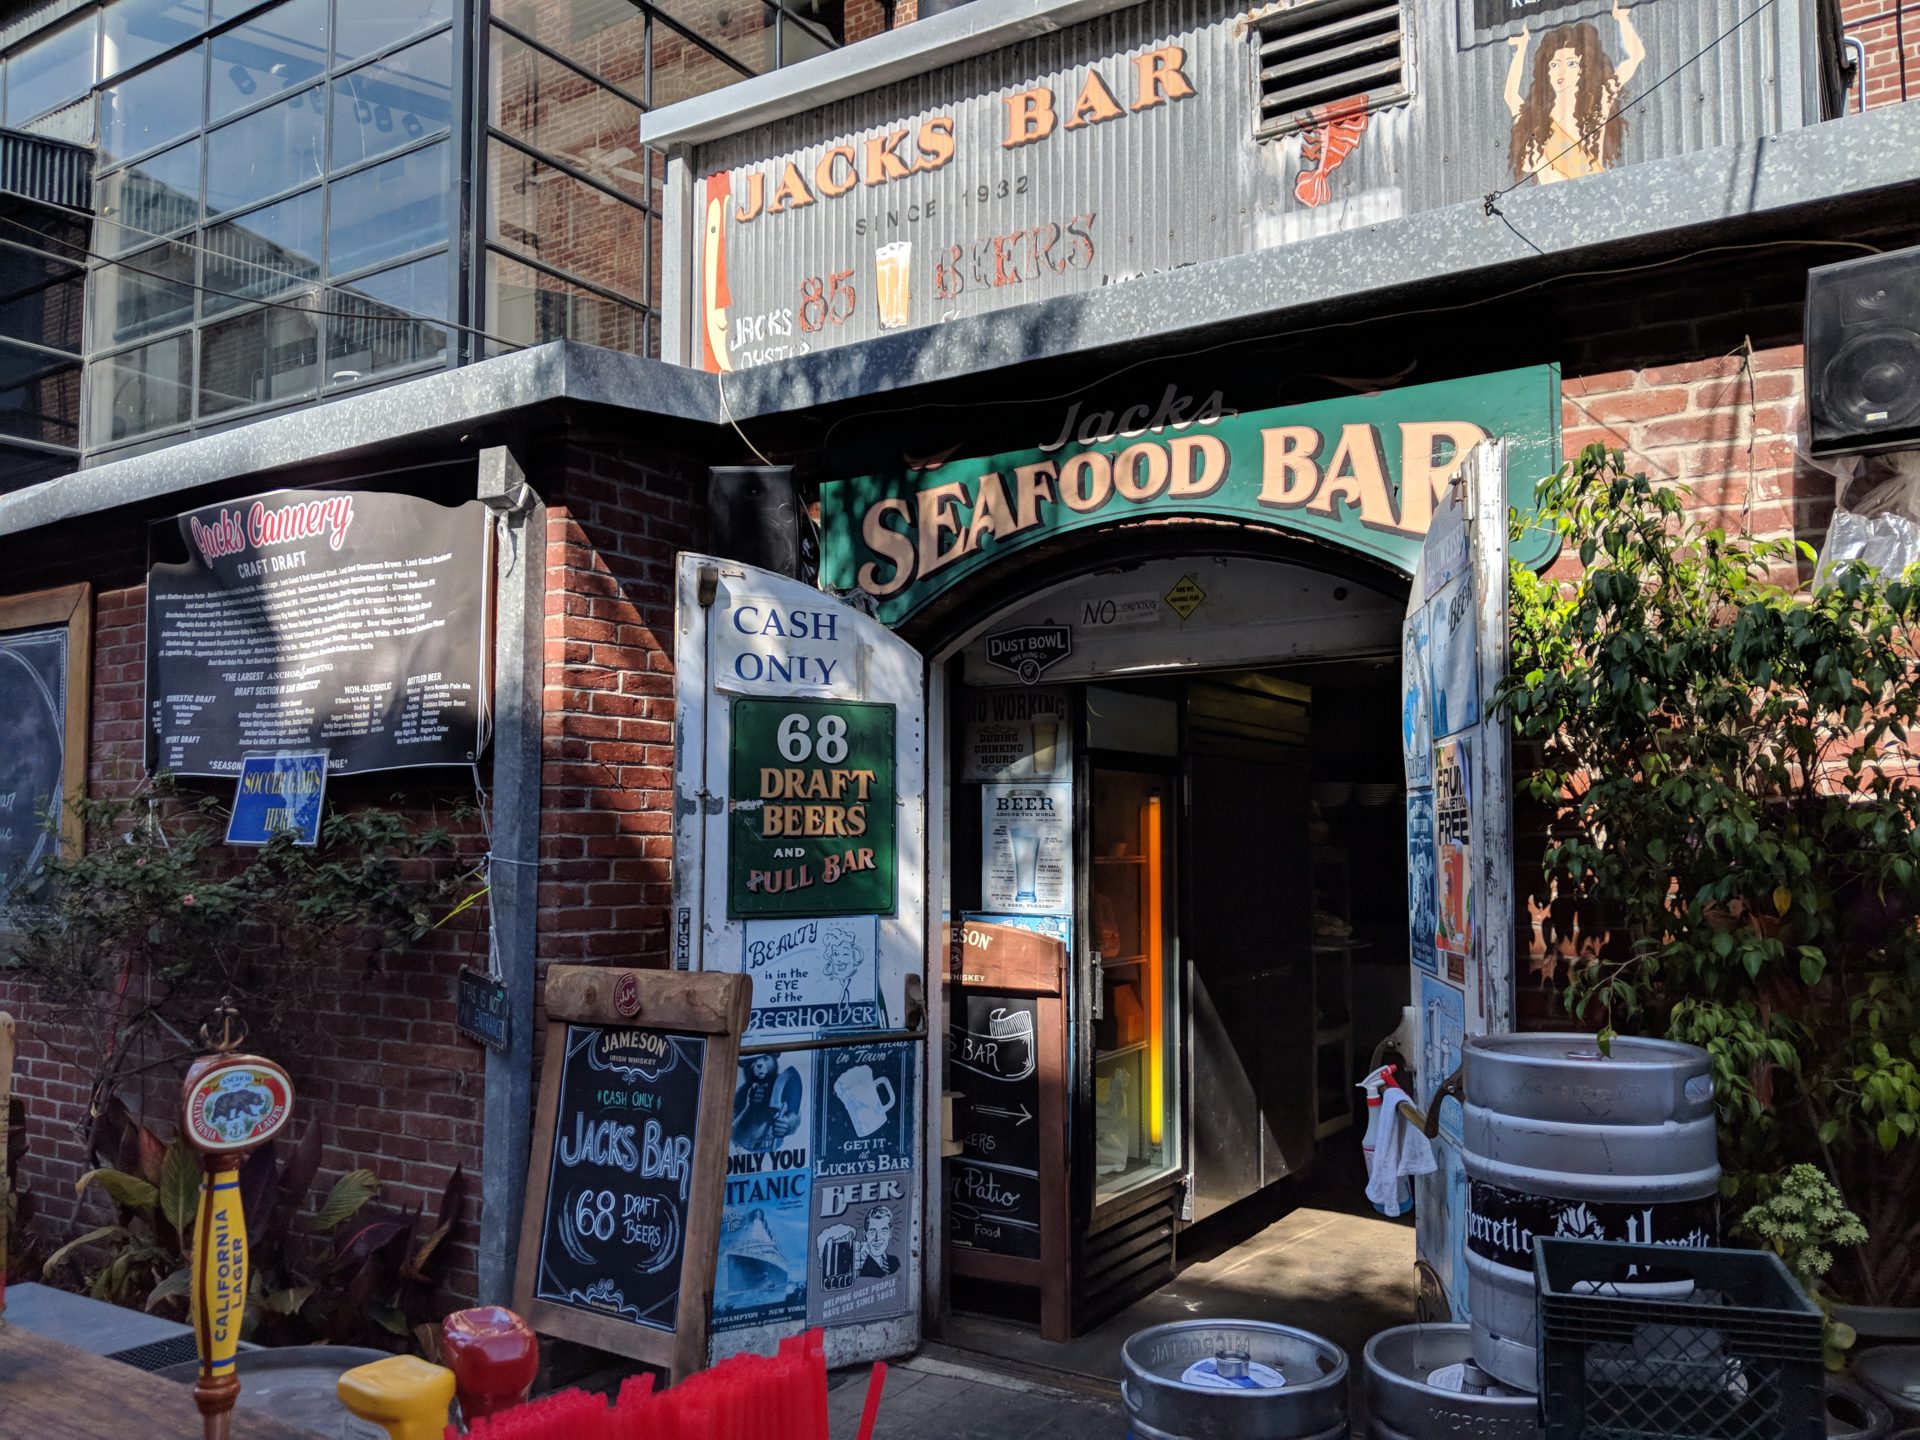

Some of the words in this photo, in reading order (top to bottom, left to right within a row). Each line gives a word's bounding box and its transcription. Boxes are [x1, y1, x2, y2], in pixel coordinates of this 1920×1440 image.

[736, 117, 956, 223] JACKS
[1002, 44, 1197, 149] BAR
[855, 200, 937, 236] SINCE
[961, 175, 1030, 207] 1932
[799, 268, 857, 333] 85
[934, 213, 1097, 300] BEERS
[730, 307, 792, 352] JACKS
[1038, 384, 1240, 453] Jacks
[857, 433, 1231, 597] SEAFOOD
[1259, 420, 1490, 541] BAR
[247, 496, 353, 551] Cannery
[237, 558, 270, 579] CRAFT
[271, 551, 306, 572] DRAFT
[1082, 599, 1117, 625] NO
[1448, 576, 1473, 636] BEER
[733, 606, 838, 641] CASH
[991, 638, 1027, 657] DUST
[1028, 631, 1066, 651] BOWL
[1010, 651, 1039, 664] BREWING
[237, 672, 265, 681] LARGEST
[267, 670, 300, 680] ANCHOR
[344, 682, 392, 694] NON-ALCOHOLIC
[407, 675, 427, 686] BOTTLED
[428, 672, 442, 682] BEER
[734, 652, 838, 686] ONLY
[194, 695, 216, 703] DRAFT
[234, 687, 254, 696] DRAFT
[255, 685, 279, 695] SECTION
[992, 693, 1065, 722] WORKING
[180, 736, 200, 744] DRAFT
[777, 713, 849, 764] 68
[974, 744, 1024, 754] DRINKING
[980, 733, 1018, 743] DURING
[981, 754, 1016, 764] HOURS
[242, 770, 286, 795] SOCCER
[287, 768, 320, 795] GAMES
[760, 768, 878, 801] DRAFT
[1437, 766, 1464, 798] FRUI
[995, 797, 1055, 811] BEER
[762, 804, 868, 837] BEERS
[1438, 809, 1470, 846] FREE
[773, 847, 805, 858] AND
[821, 847, 876, 884] BAR
[749, 920, 818, 969] BEAUTY
[950, 927, 992, 951] ESON
[765, 970, 773, 980] is
[777, 968, 787, 979] in
[790, 967, 808, 978] the
[774, 979, 799, 991] EYE
[770, 992, 783, 1003] of
[784, 991, 803, 1002] the
[750, 1005, 875, 1030] BEERHOLDER
[601, 1030, 667, 1058] JAMESON
[961, 1038, 1001, 1073] BAR
[609, 1055, 627, 1063] IRISH
[627, 1056, 656, 1066] WHISKEY
[836, 1052, 849, 1065] in
[602, 1090, 628, 1107] CASH
[632, 1090, 655, 1110] ONLY
[193, 1092, 217, 1140] CALIFORNIA
[257, 1104, 284, 1132] LAGER
[561, 1111, 639, 1174] JACKS
[641, 1118, 693, 1200] BAR
[769, 1148, 806, 1171] YOU
[815, 1158, 876, 1177] LUCKY'S
[878, 1154, 910, 1171] BAR
[858, 1150, 870, 1160] at
[726, 1174, 806, 1206] ITANIC
[820, 1179, 905, 1218] BEER
[576, 1190, 615, 1242] 68
[622, 1193, 660, 1220] DRAFT
[623, 1217, 661, 1250] BEERS
[213, 1208, 229, 1343] CALIFORNIA
[231, 1238, 243, 1312] LAGER
[822, 1308, 840, 1320] HAVE
[842, 1303, 854, 1314] SEX
[856, 1295, 875, 1308] SINCE
[823, 1292, 852, 1310] HELPING
[853, 1287, 870, 1299] UGLY
[871, 1278, 896, 1293] PEOPLE
[711, 1311, 759, 1325] UTHAMPTON
[768, 1307, 785, 1316] NEW
[787, 1304, 807, 1313] YORK
